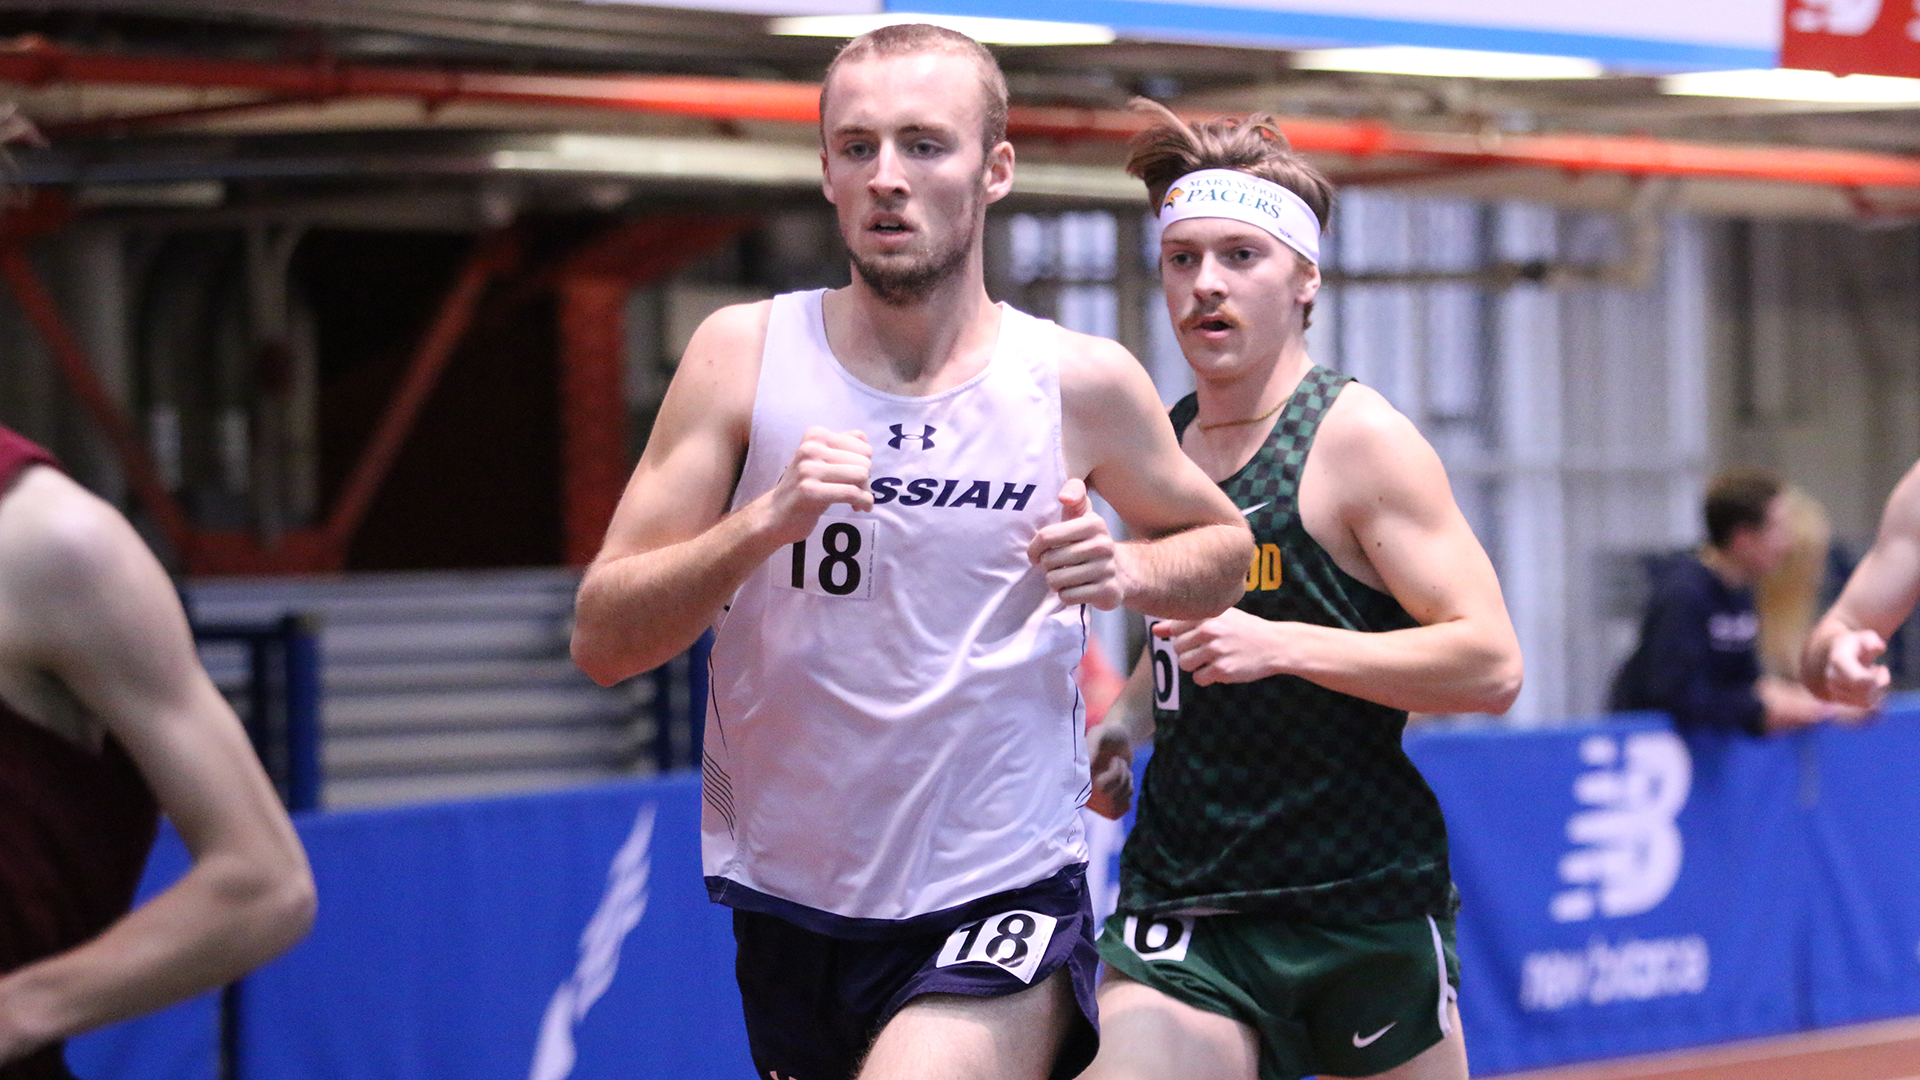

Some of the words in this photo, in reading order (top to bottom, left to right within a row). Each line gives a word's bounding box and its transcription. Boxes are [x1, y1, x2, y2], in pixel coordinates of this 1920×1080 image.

[1185, 188, 1282, 219] PACERS
[1188, 178, 1283, 204] MARYWOOD
[870, 476, 1038, 512] SSIAH
[791, 522, 862, 596] 18
[955, 913, 1037, 968] 18
